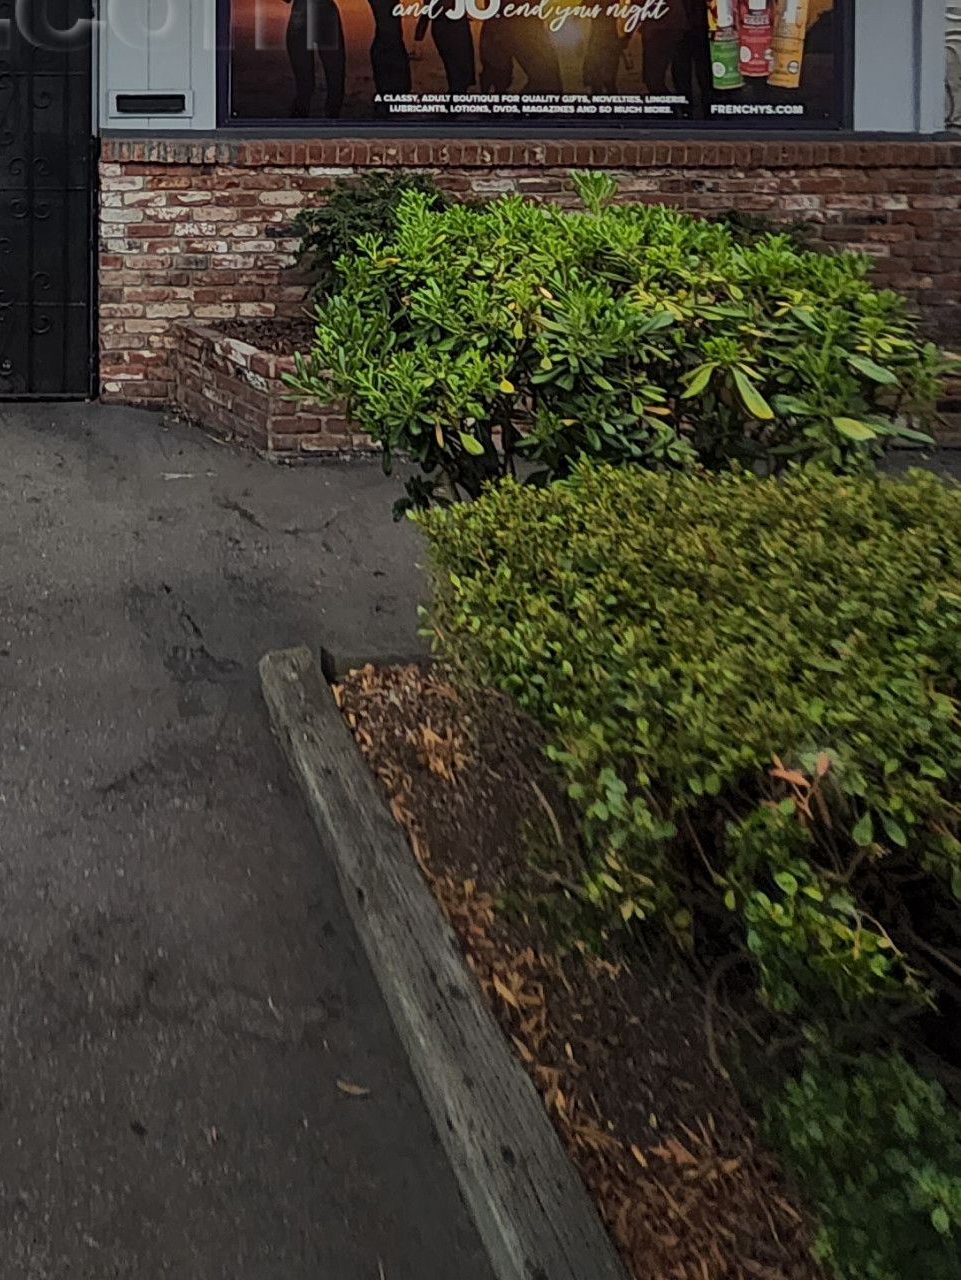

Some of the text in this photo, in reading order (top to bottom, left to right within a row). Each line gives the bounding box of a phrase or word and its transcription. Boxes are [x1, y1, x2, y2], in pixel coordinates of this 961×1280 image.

[549, 3, 603, 32] your
[374, 94, 383, 103] A
[384, 94, 420, 104] CLASSY,
[421, 94, 451, 103] ADULT
[452, 95, 500, 104] BOUTIQUE
[501, 95, 520, 103] FOR
[521, 95, 560, 104] QUALITY
[389, 105, 449, 114] LUBRICANTS,
[450, 105, 492, 114] LOTIONS,
[493, 105, 521, 114] DVDS,
[522, 105, 575, 114] MAGAZINES
[576, 105, 597, 114] AND
[599, 106, 612, 114] SO
[613, 106, 643, 114] MUCH
[710, 104, 804, 114] FRENCHYS.COM
